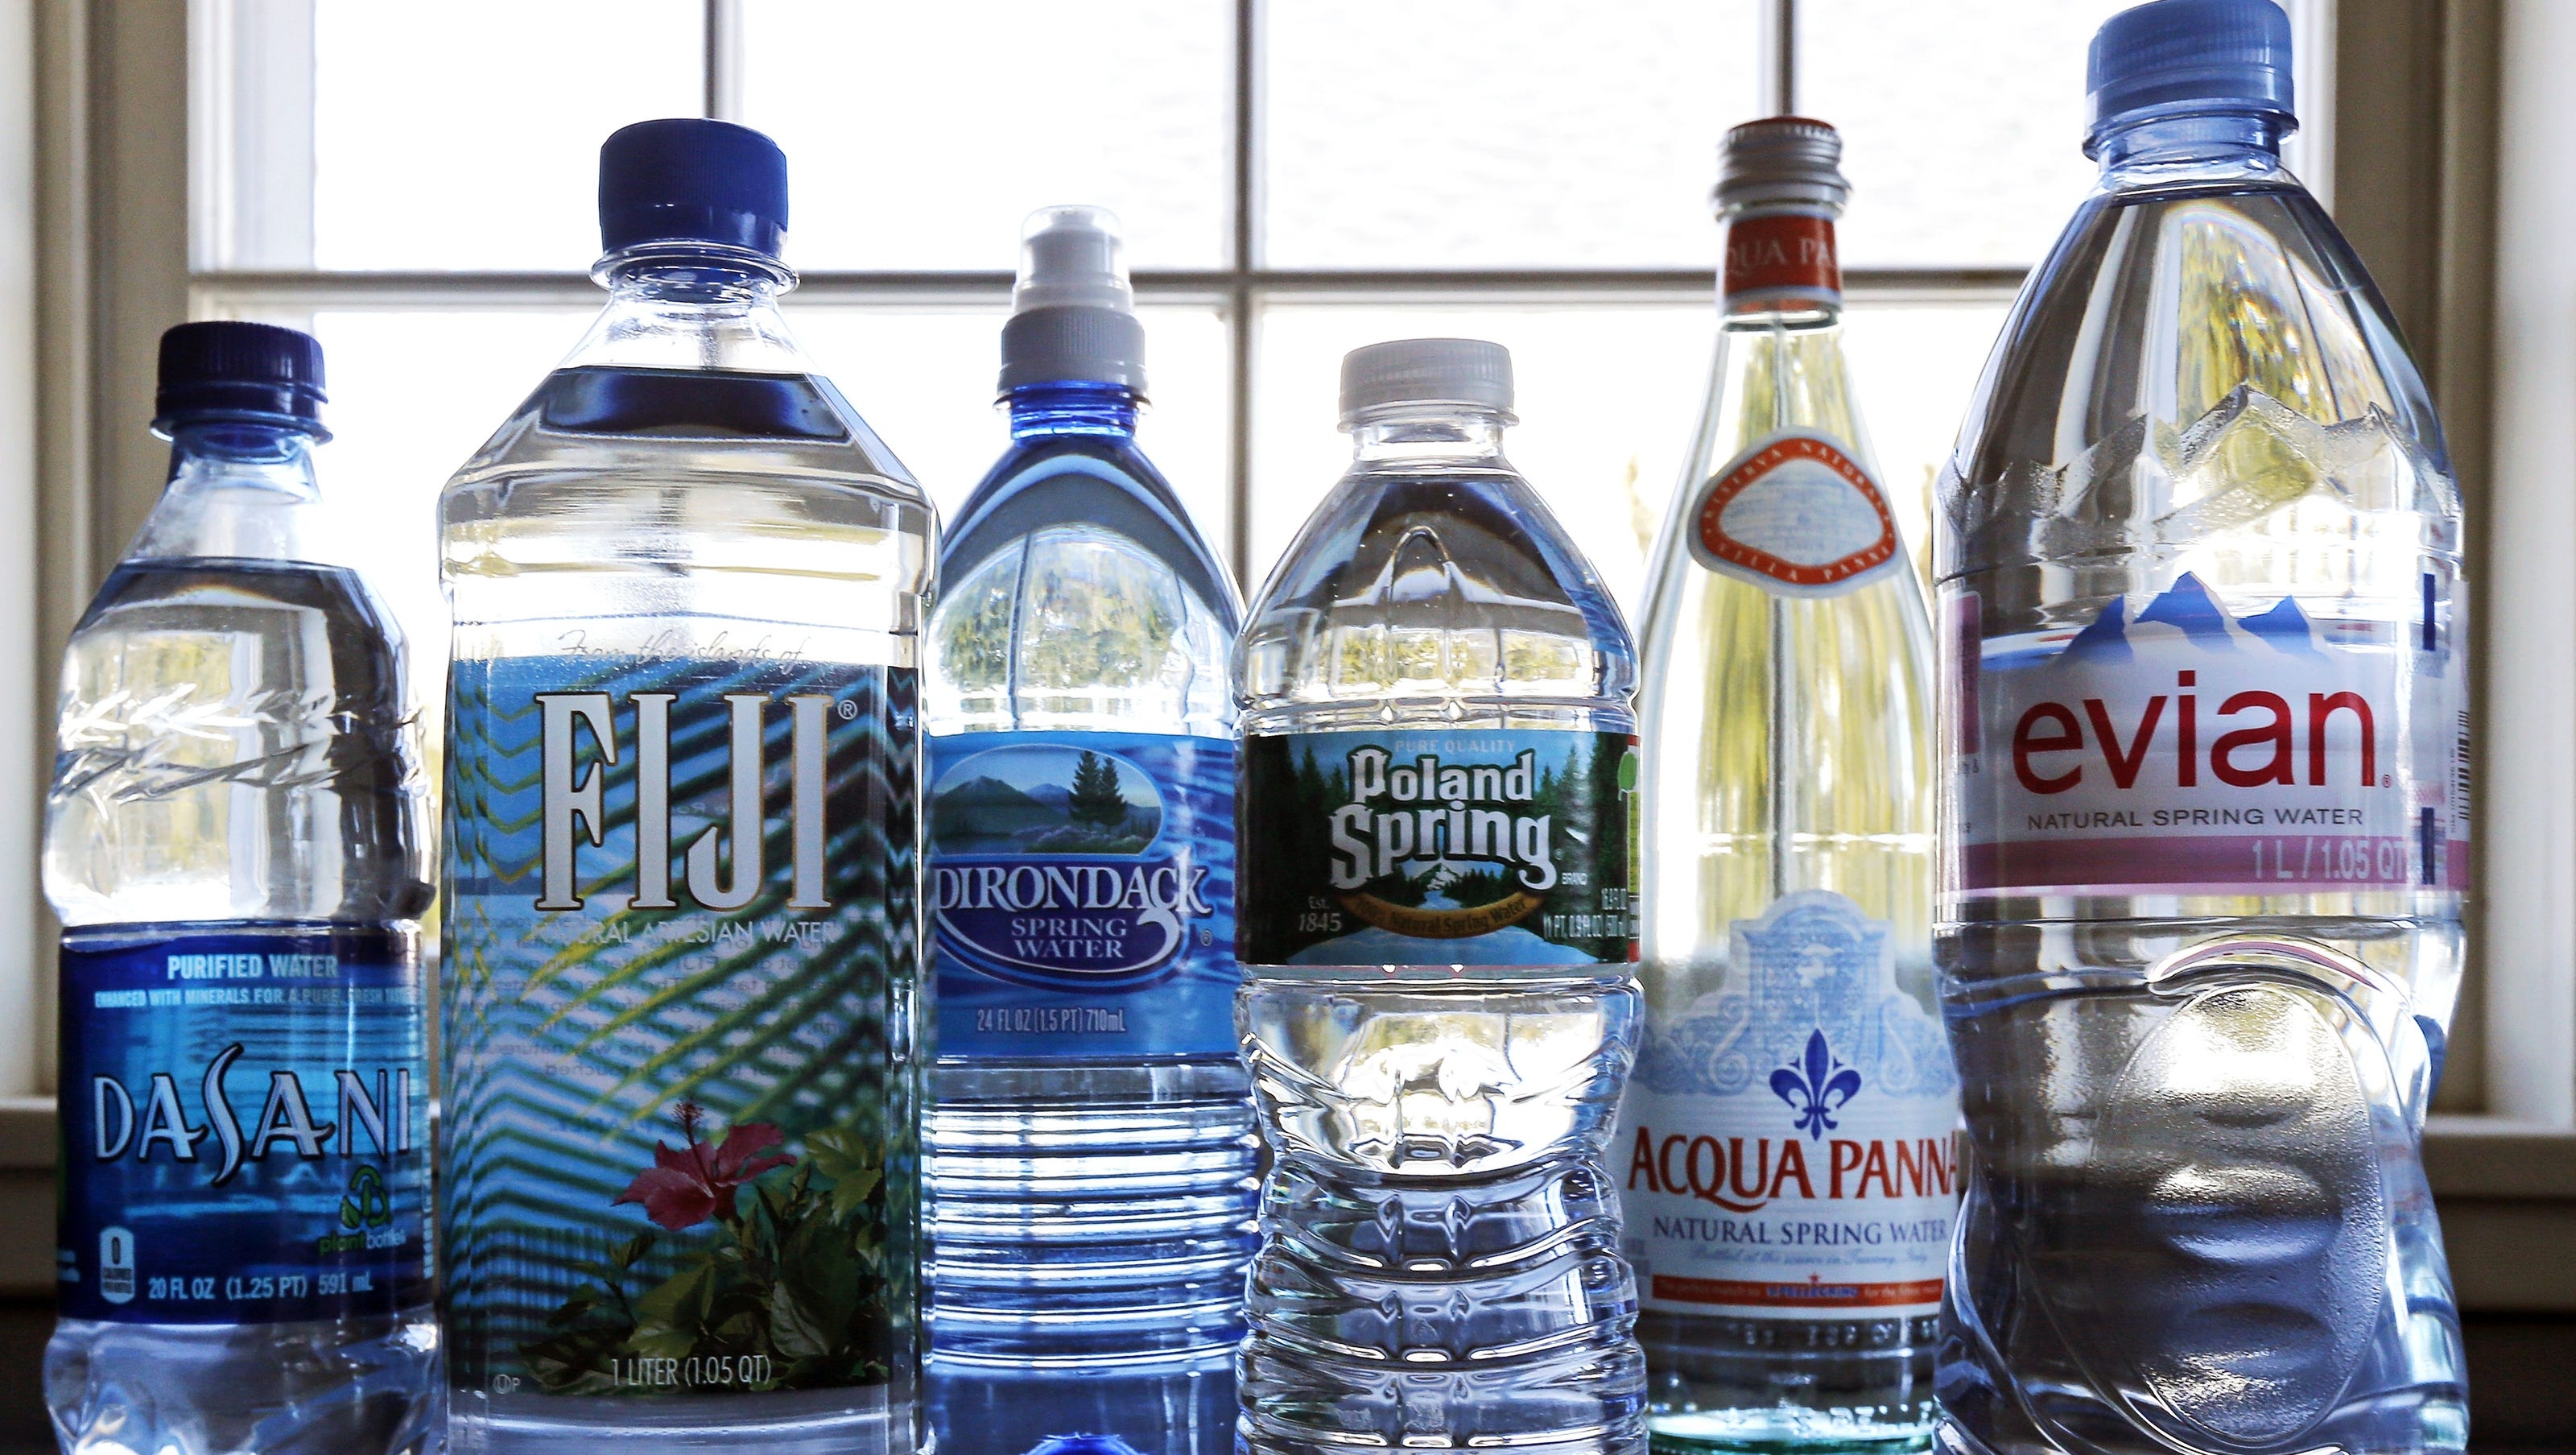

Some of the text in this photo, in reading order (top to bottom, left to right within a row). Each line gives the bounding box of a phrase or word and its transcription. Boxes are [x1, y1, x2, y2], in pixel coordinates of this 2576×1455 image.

[558, 629, 811, 675] From the islands of
[2013, 670, 2376, 794] evian
[1395, 739, 1516, 754] PURE QUALITY
[1349, 747, 1534, 803] Poland
[534, 691, 835, 911] FIJI
[2028, 808, 2363, 831] NATURAL SPRING WATER
[1328, 801, 1558, 891] Spring
[2252, 840, 2263, 878] 1
[2276, 839, 2293, 878] L
[2322, 839, 2370, 879] 1.05
[1308, 896, 1330, 909] Est.
[759, 920, 837, 944] WATER
[1011, 917, 1127, 937] SPRING
[1298, 911, 1343, 932] 1845
[1013, 940, 1125, 958] WATER
[167, 953, 339, 979] PURIFIED WATER
[148, 988, 181, 1006] WITH
[184, 987, 250, 1005] MINERALS
[254, 987, 283, 1003] FOR
[977, 1007, 1126, 1033] 24 FL OZ (1.5 PT) 710mL
[93, 1043, 411, 1188] DASANI
[1627, 1126, 1815, 1212] ACQUA
[1652, 1216, 1948, 1246] NATURAL SPRING WATER
[149, 1277, 166, 1300] 20
[170, 1277, 188, 1300] FL
[191, 1277, 216, 1300] OZ
[225, 1277, 274, 1300] (1.25
[279, 1275, 308, 1298] PT)
[319, 1273, 346, 1295] 591
[612, 1354, 771, 1386] 1 LITER (1.05 QT)
